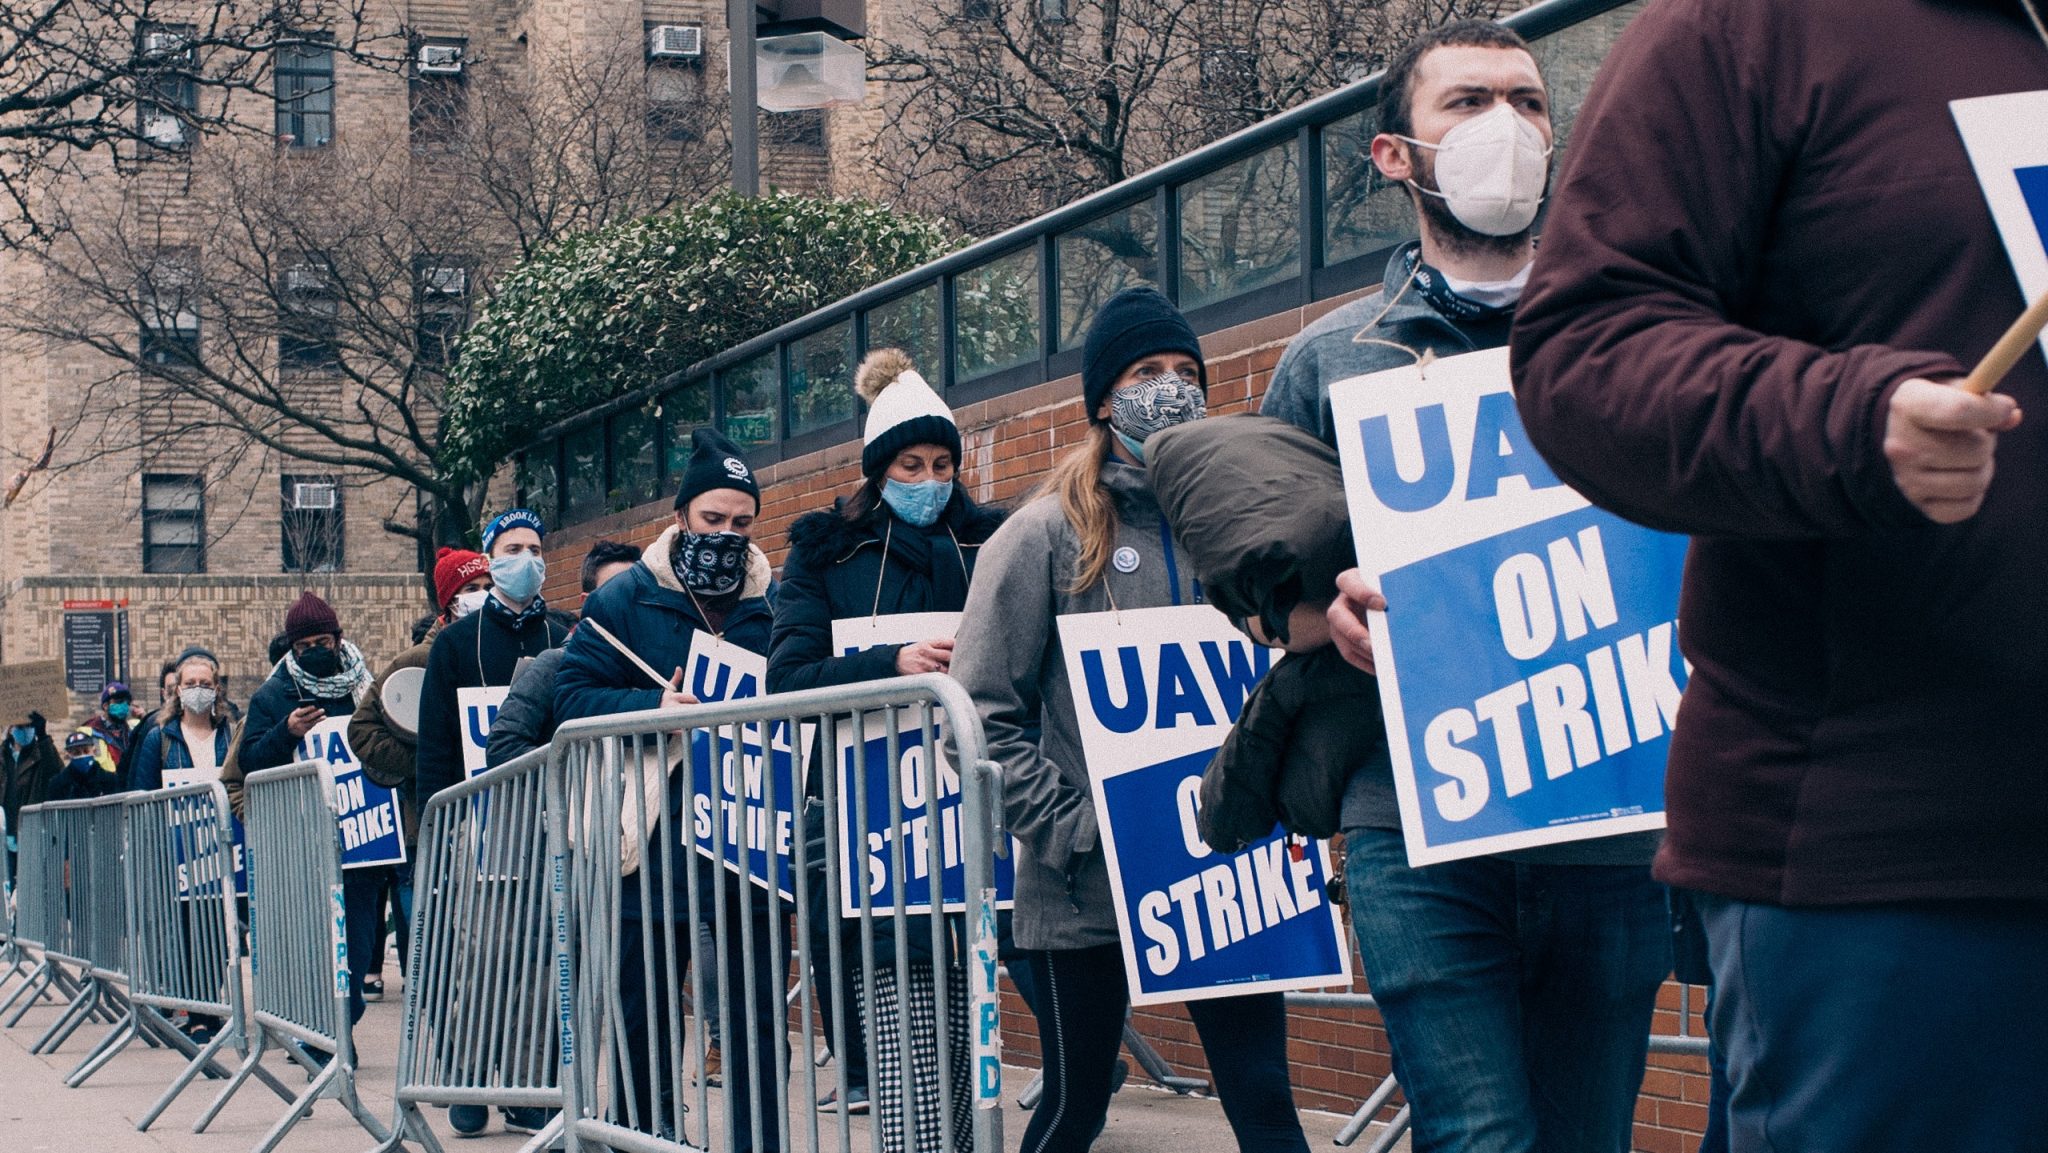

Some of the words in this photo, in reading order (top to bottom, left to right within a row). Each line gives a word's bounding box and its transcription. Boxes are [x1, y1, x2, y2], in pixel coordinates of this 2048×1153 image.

[1359, 391, 1566, 513] UA
[499, 511, 541, 529] BROOKLYN
[1493, 525, 1618, 661] ON
[1080, 640, 1271, 733] UAW
[1424, 619, 1693, 822] STRIK
[298, 731, 353, 765] UA
[723, 751, 763, 799] ON
[900, 740, 960, 809] ON
[336, 776, 365, 815] ON
[339, 802, 394, 851] RIKE
[1176, 775, 1211, 858] O
[858, 803, 964, 896] STRI
[1138, 832, 1320, 976] STRIKE
[978, 901, 1001, 1098] NYPD
